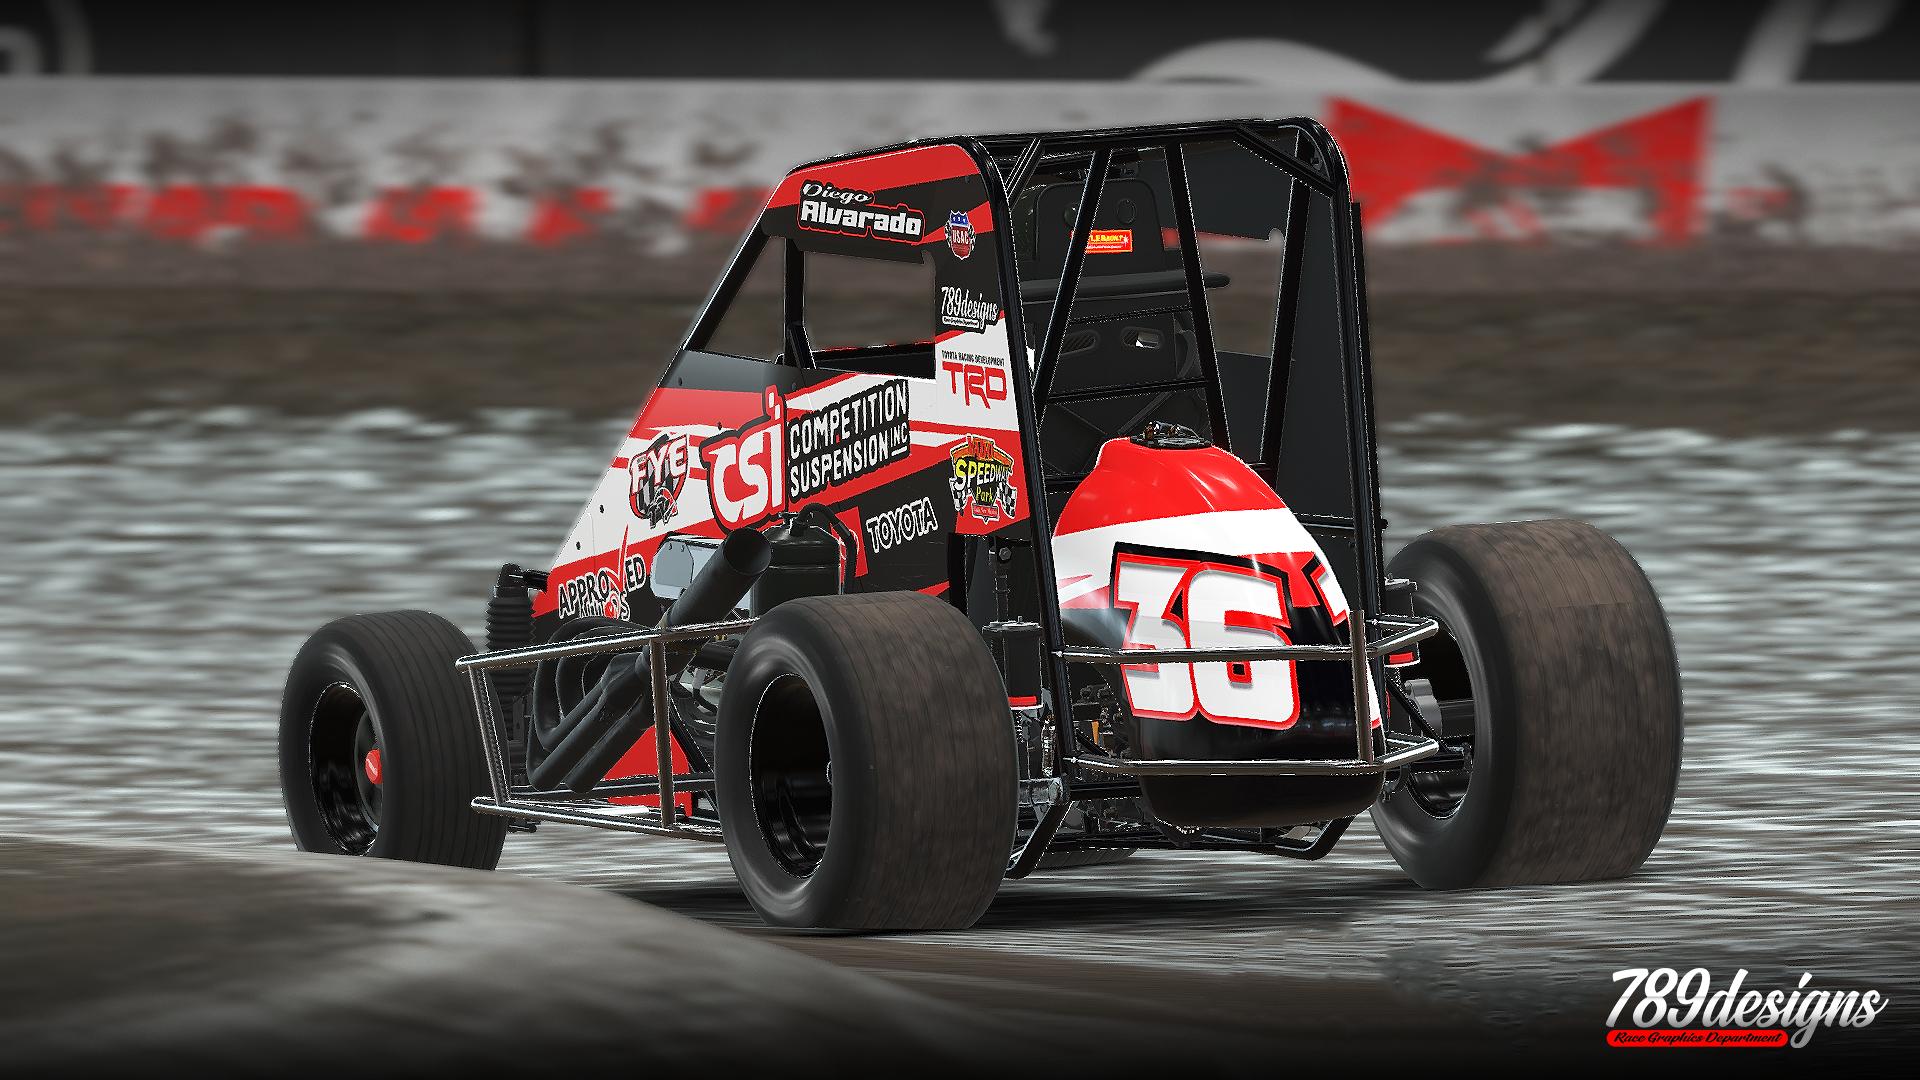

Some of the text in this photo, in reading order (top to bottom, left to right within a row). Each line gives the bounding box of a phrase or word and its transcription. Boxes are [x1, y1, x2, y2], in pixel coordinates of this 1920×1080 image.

[800, 200, 922, 236] Alvarado
[802, 182, 872, 205] Diego
[952, 229, 969, 245] USAC
[941, 286, 999, 330] 789designs
[941, 360, 1008, 410] TRD
[789, 381, 907, 460] COMPETITION
[630, 436, 687, 495] FYE
[789, 424, 908, 498] SUSPENSION INC
[976, 485, 994, 503] Park
[865, 497, 939, 554] TOYOTA
[558, 524, 647, 620] APPROVED
[1113, 551, 1301, 731] 36
